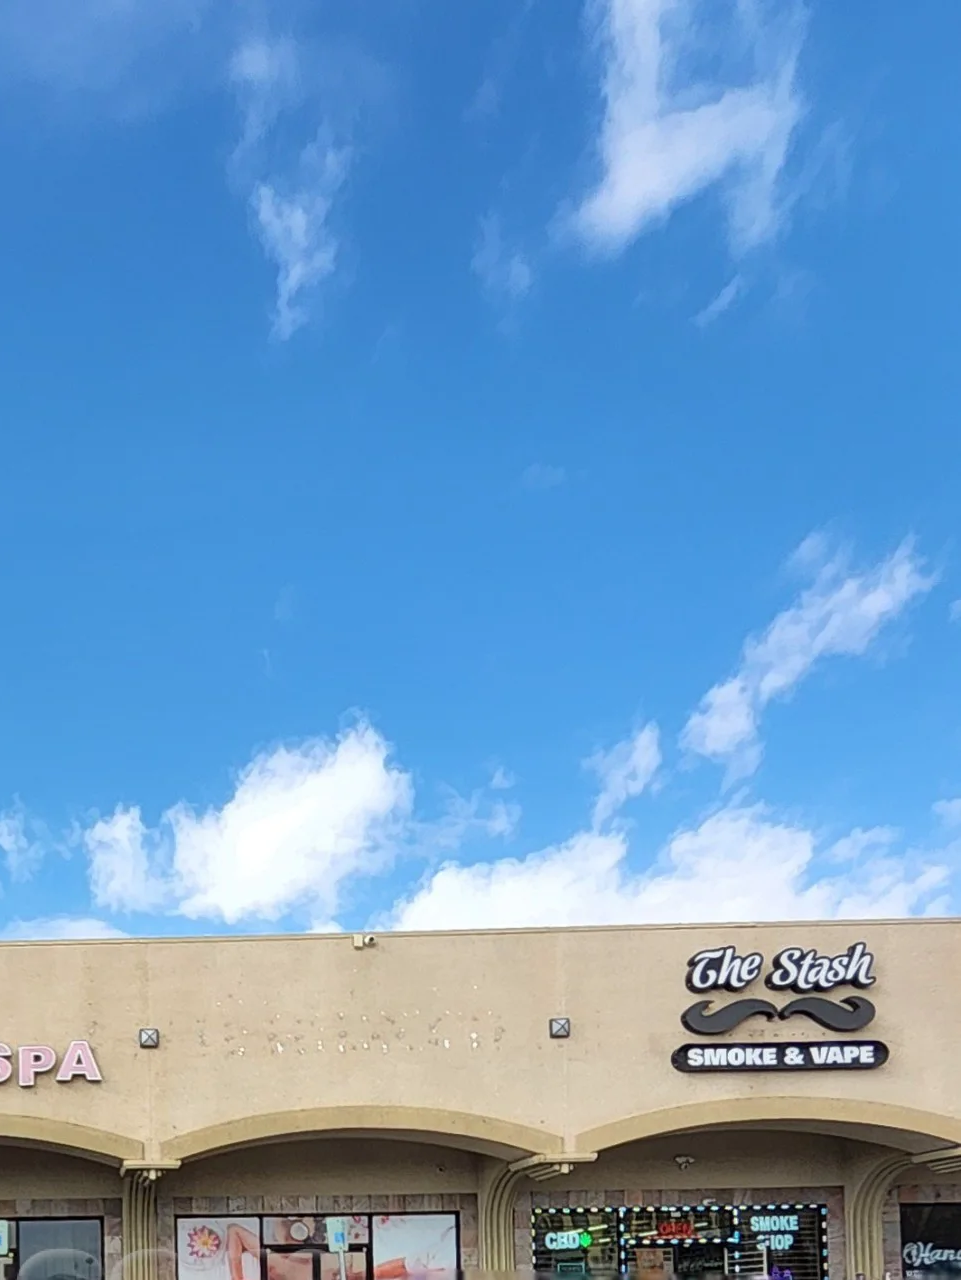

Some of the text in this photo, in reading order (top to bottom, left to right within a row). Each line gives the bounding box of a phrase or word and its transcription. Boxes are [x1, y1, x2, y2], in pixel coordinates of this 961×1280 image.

[690, 942, 876, 990] The Stash
[687, 1045, 875, 1066] SMOKE & VAPE
[750, 1215, 799, 1231] SMOKE
[545, 1231, 580, 1249] CBD
